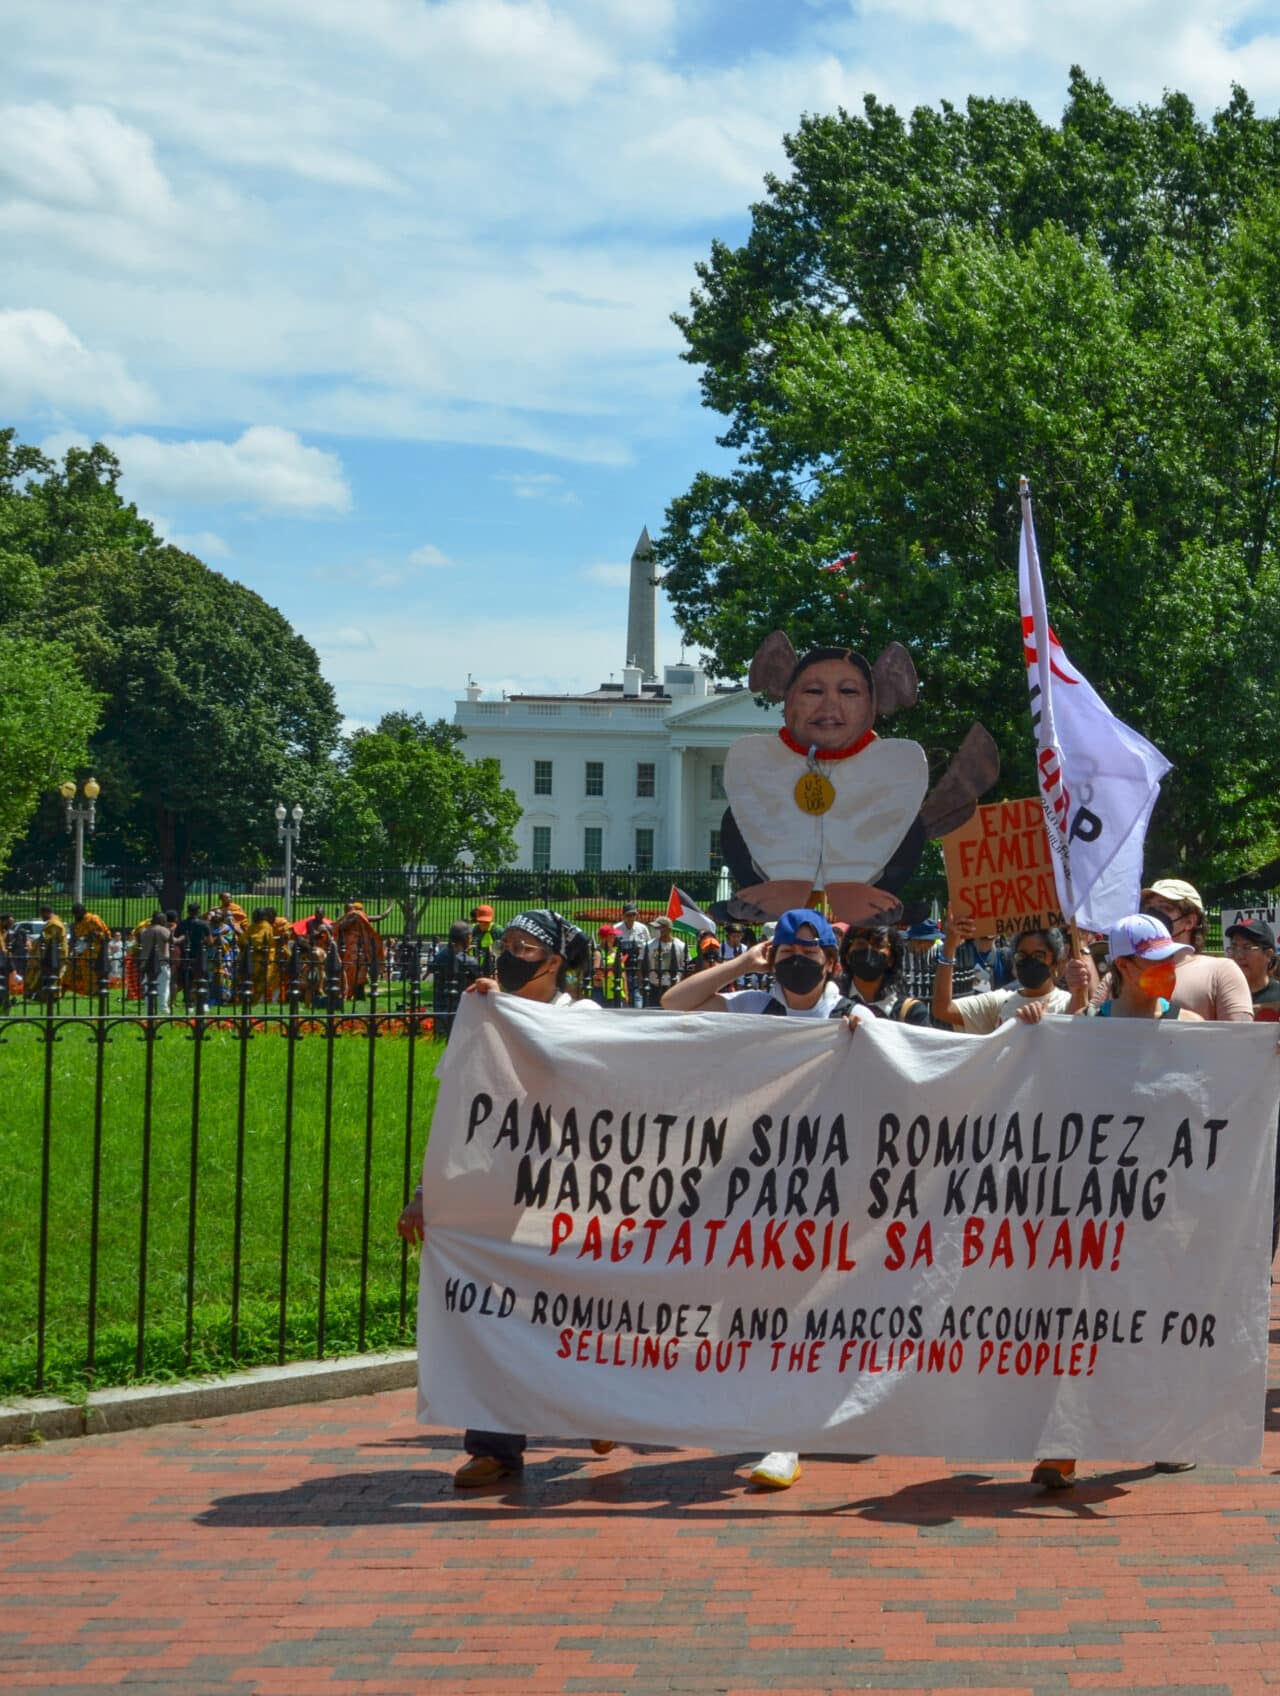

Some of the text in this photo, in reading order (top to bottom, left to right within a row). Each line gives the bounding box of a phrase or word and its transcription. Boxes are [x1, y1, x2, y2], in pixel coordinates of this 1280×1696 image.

[979, 800, 1043, 838] END
[996, 915, 1041, 935] BAYAN
[465, 1093, 1229, 1170] PANAGUTIN SINA ROMUALDEZ AT
[513, 1154, 1168, 1221] MARCOS PARA SA KANILANG
[549, 1213, 1125, 1272] PAGTATAKSIL SA BAYAN!
[445, 1277, 1217, 1348] HOLD ROMUALDEZ AND MARCOS ACCOUNTABLE FOR
[557, 1328, 1098, 1377] SELLING OUT THE FILIPINO PEOPLE!
